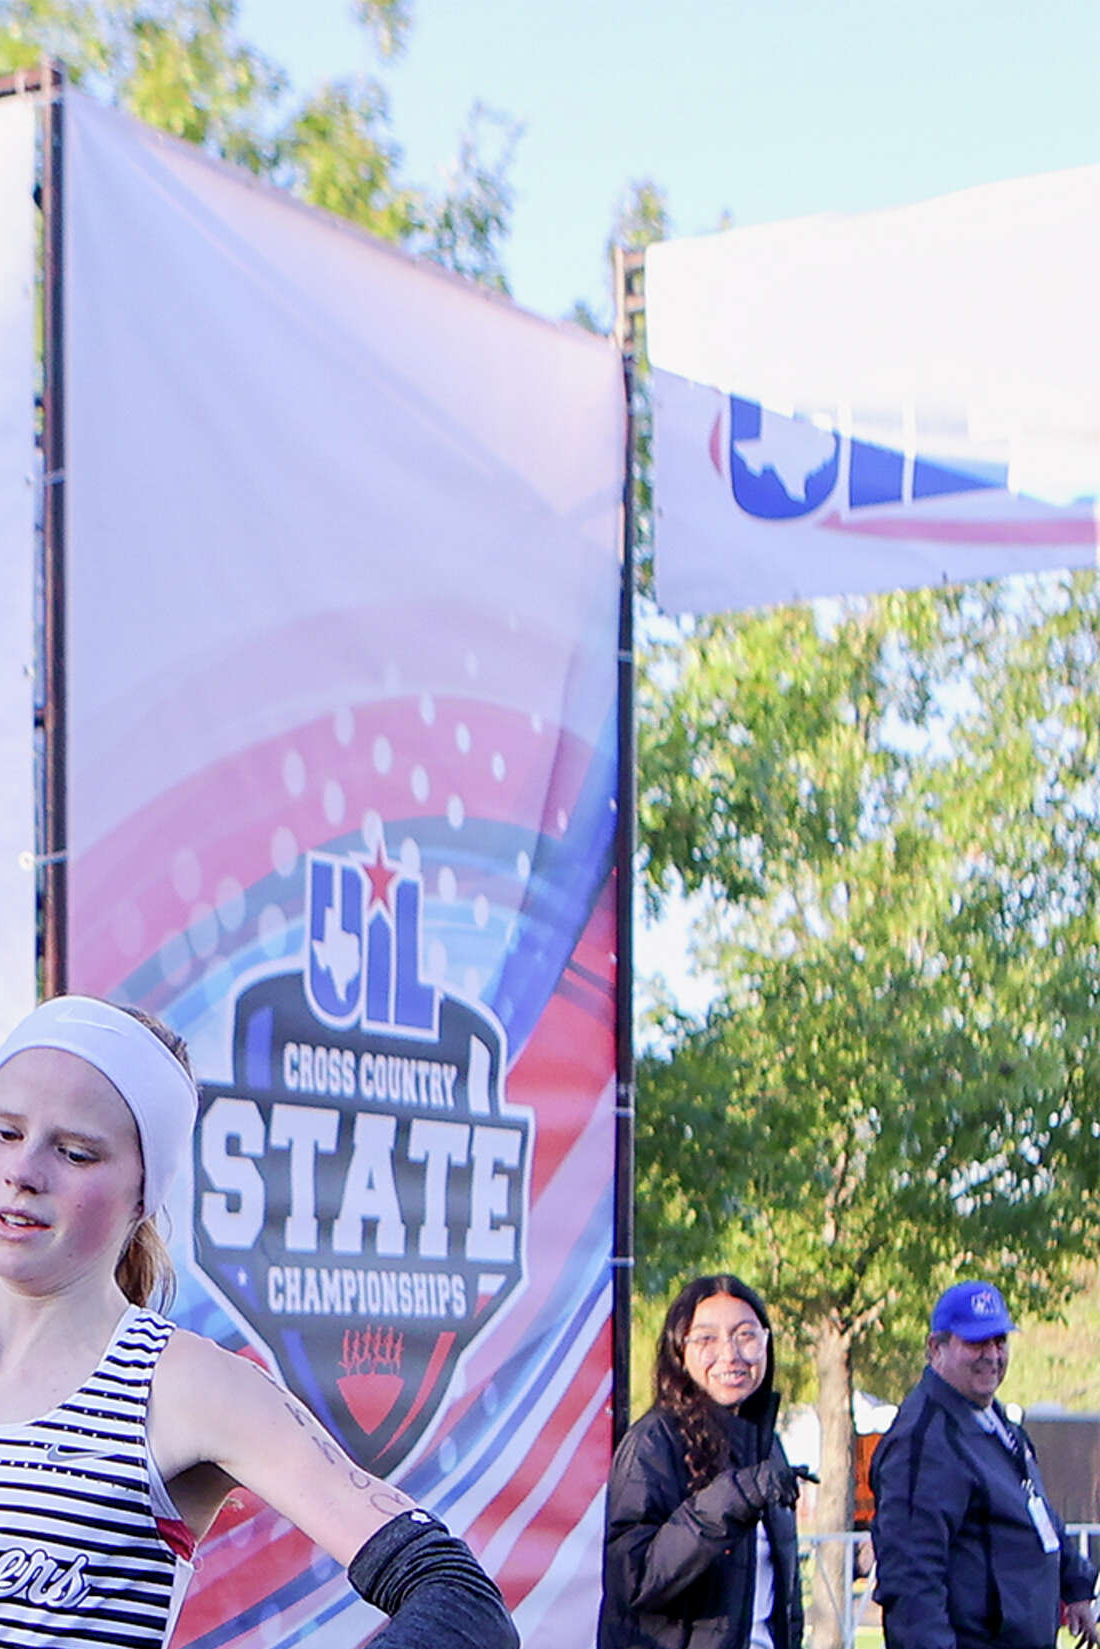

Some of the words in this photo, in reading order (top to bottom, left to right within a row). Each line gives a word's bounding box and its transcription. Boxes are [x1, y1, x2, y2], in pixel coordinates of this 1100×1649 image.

[307, 844, 438, 1032] UIL
[283, 1041, 357, 1098] CROSS
[360, 1052, 459, 1112] COUNTRY
[201, 1097, 523, 1264] STATE
[267, 1266, 468, 1319] CHAMPIONSHIPS
